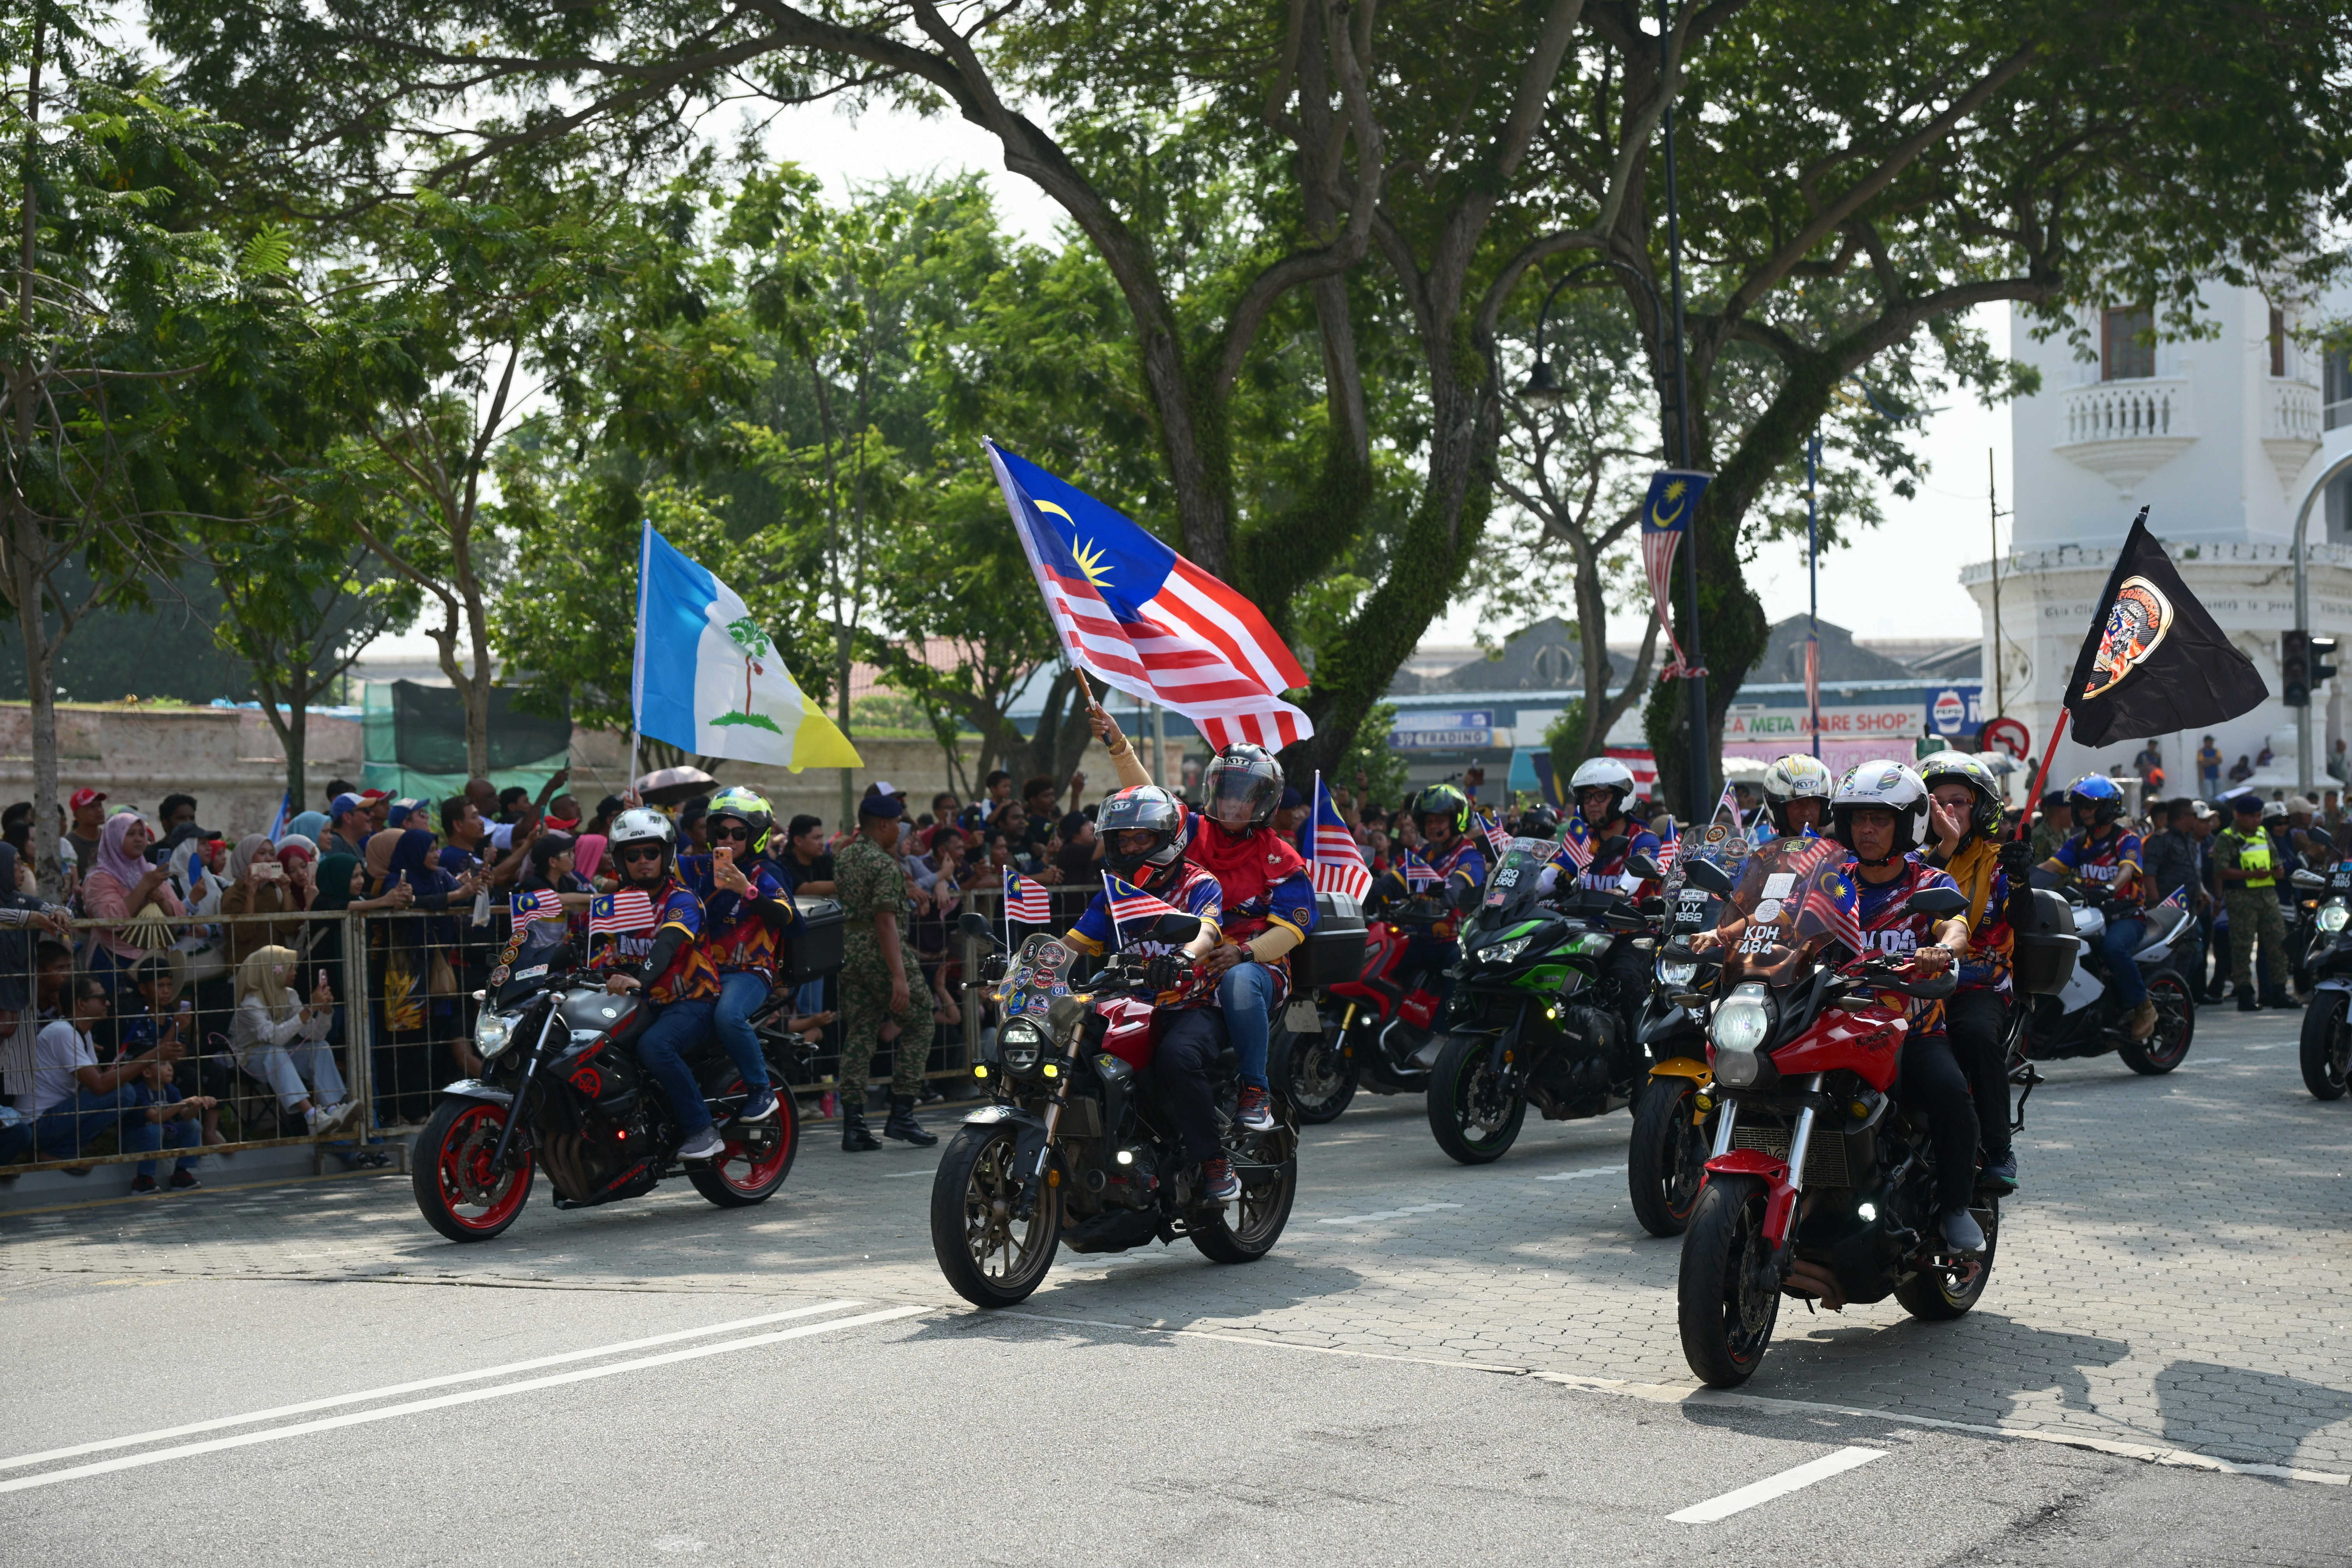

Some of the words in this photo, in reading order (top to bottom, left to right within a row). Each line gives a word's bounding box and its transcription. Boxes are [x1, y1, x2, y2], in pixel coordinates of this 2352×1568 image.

[2118, 588, 2159, 628] FRIENDSHIP
[2127, 604, 2142, 618] since
[2119, 611, 2135, 624] 2011
[2100, 656, 2111, 667] RIDE
[1750, 716, 1794, 733] META
[1857, 713, 1907, 731] SHOP
[1397, 733, 1413, 746] 39
[1421, 731, 1482, 744] TRADING
[1788, 755, 1816, 776] 65
[1929, 762, 1955, 770] KYT
[1794, 780, 1817, 788] KYT
[1499, 868, 1519, 879] BRQ
[1494, 877, 1516, 887] 5166
[1681, 903, 1701, 912] VY
[1675, 912, 1703, 922] 1862
[1744, 925, 1780, 940] KDH
[1739, 940, 1773, 955] 484
[607, 1164, 646, 1191] YAMAHA
